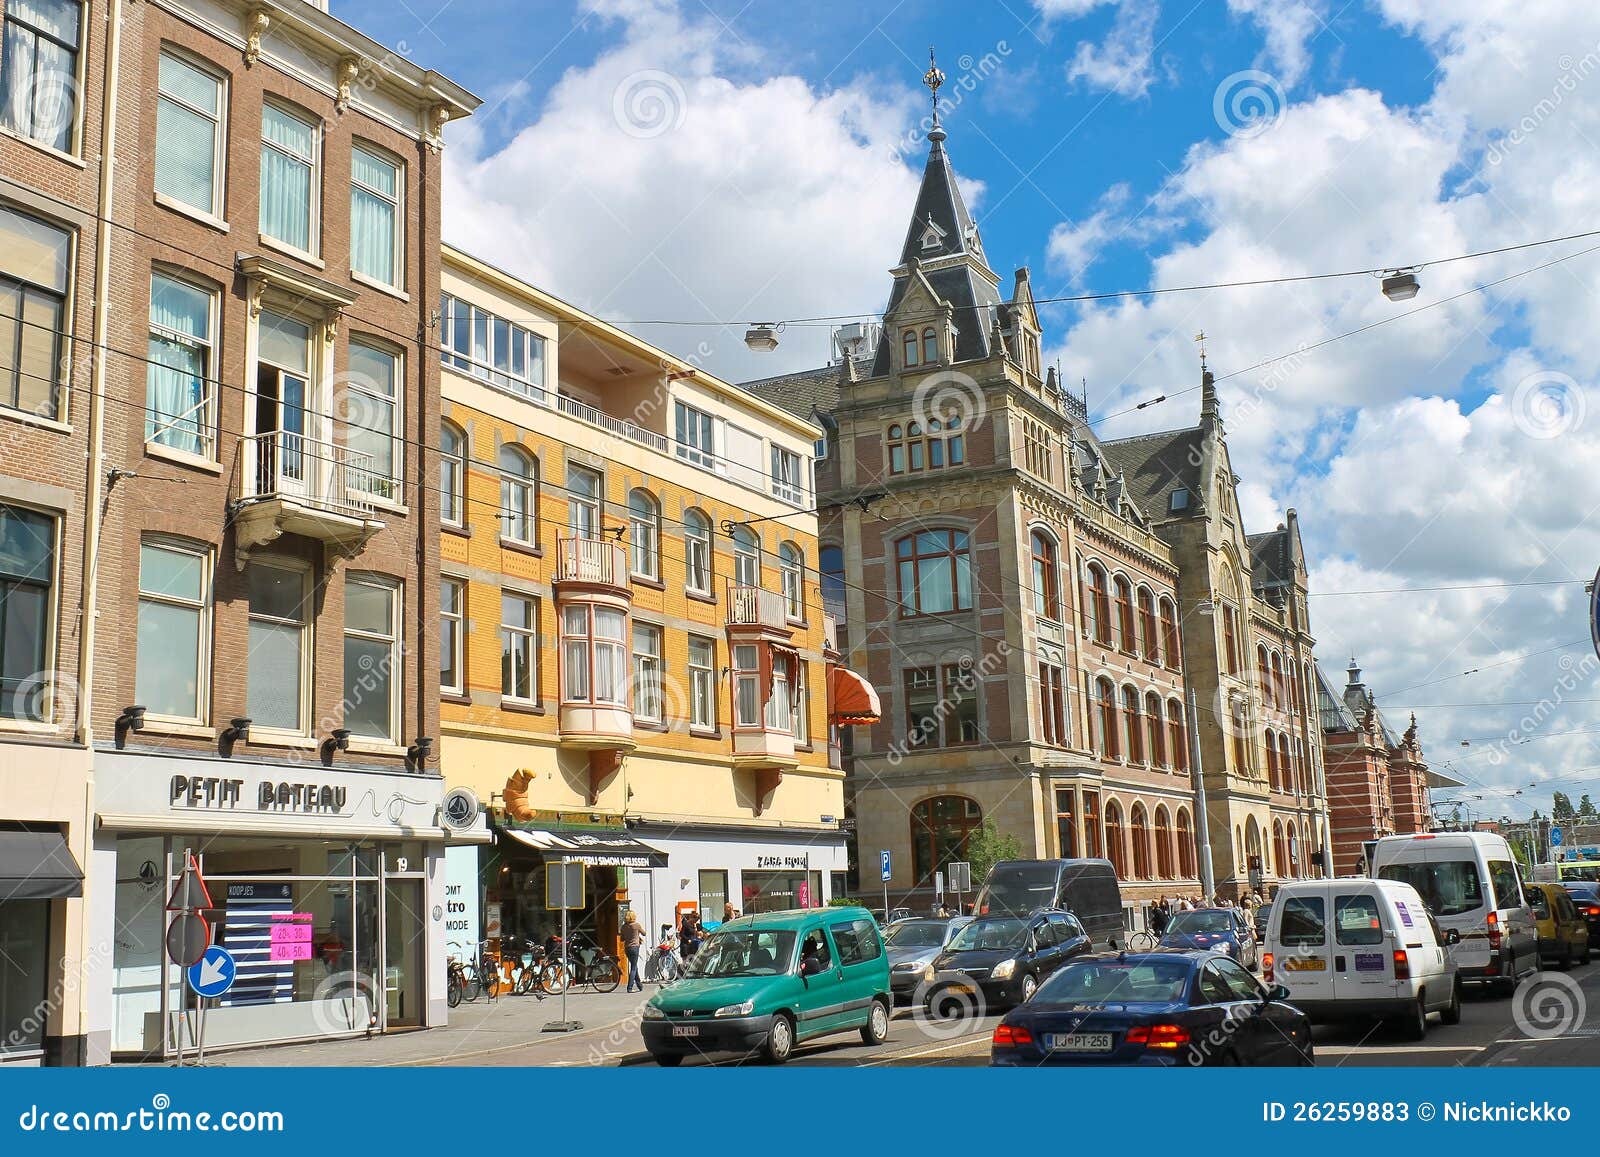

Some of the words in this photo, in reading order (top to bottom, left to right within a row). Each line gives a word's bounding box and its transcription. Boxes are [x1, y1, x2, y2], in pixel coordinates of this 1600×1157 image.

[171, 775, 244, 808] PETIT
[258, 781, 347, 813] BATEAU
[396, 857, 408, 872] 19
[446, 920, 469, 931] MODE
[1074, 1035, 1108, 1047] PT-256
